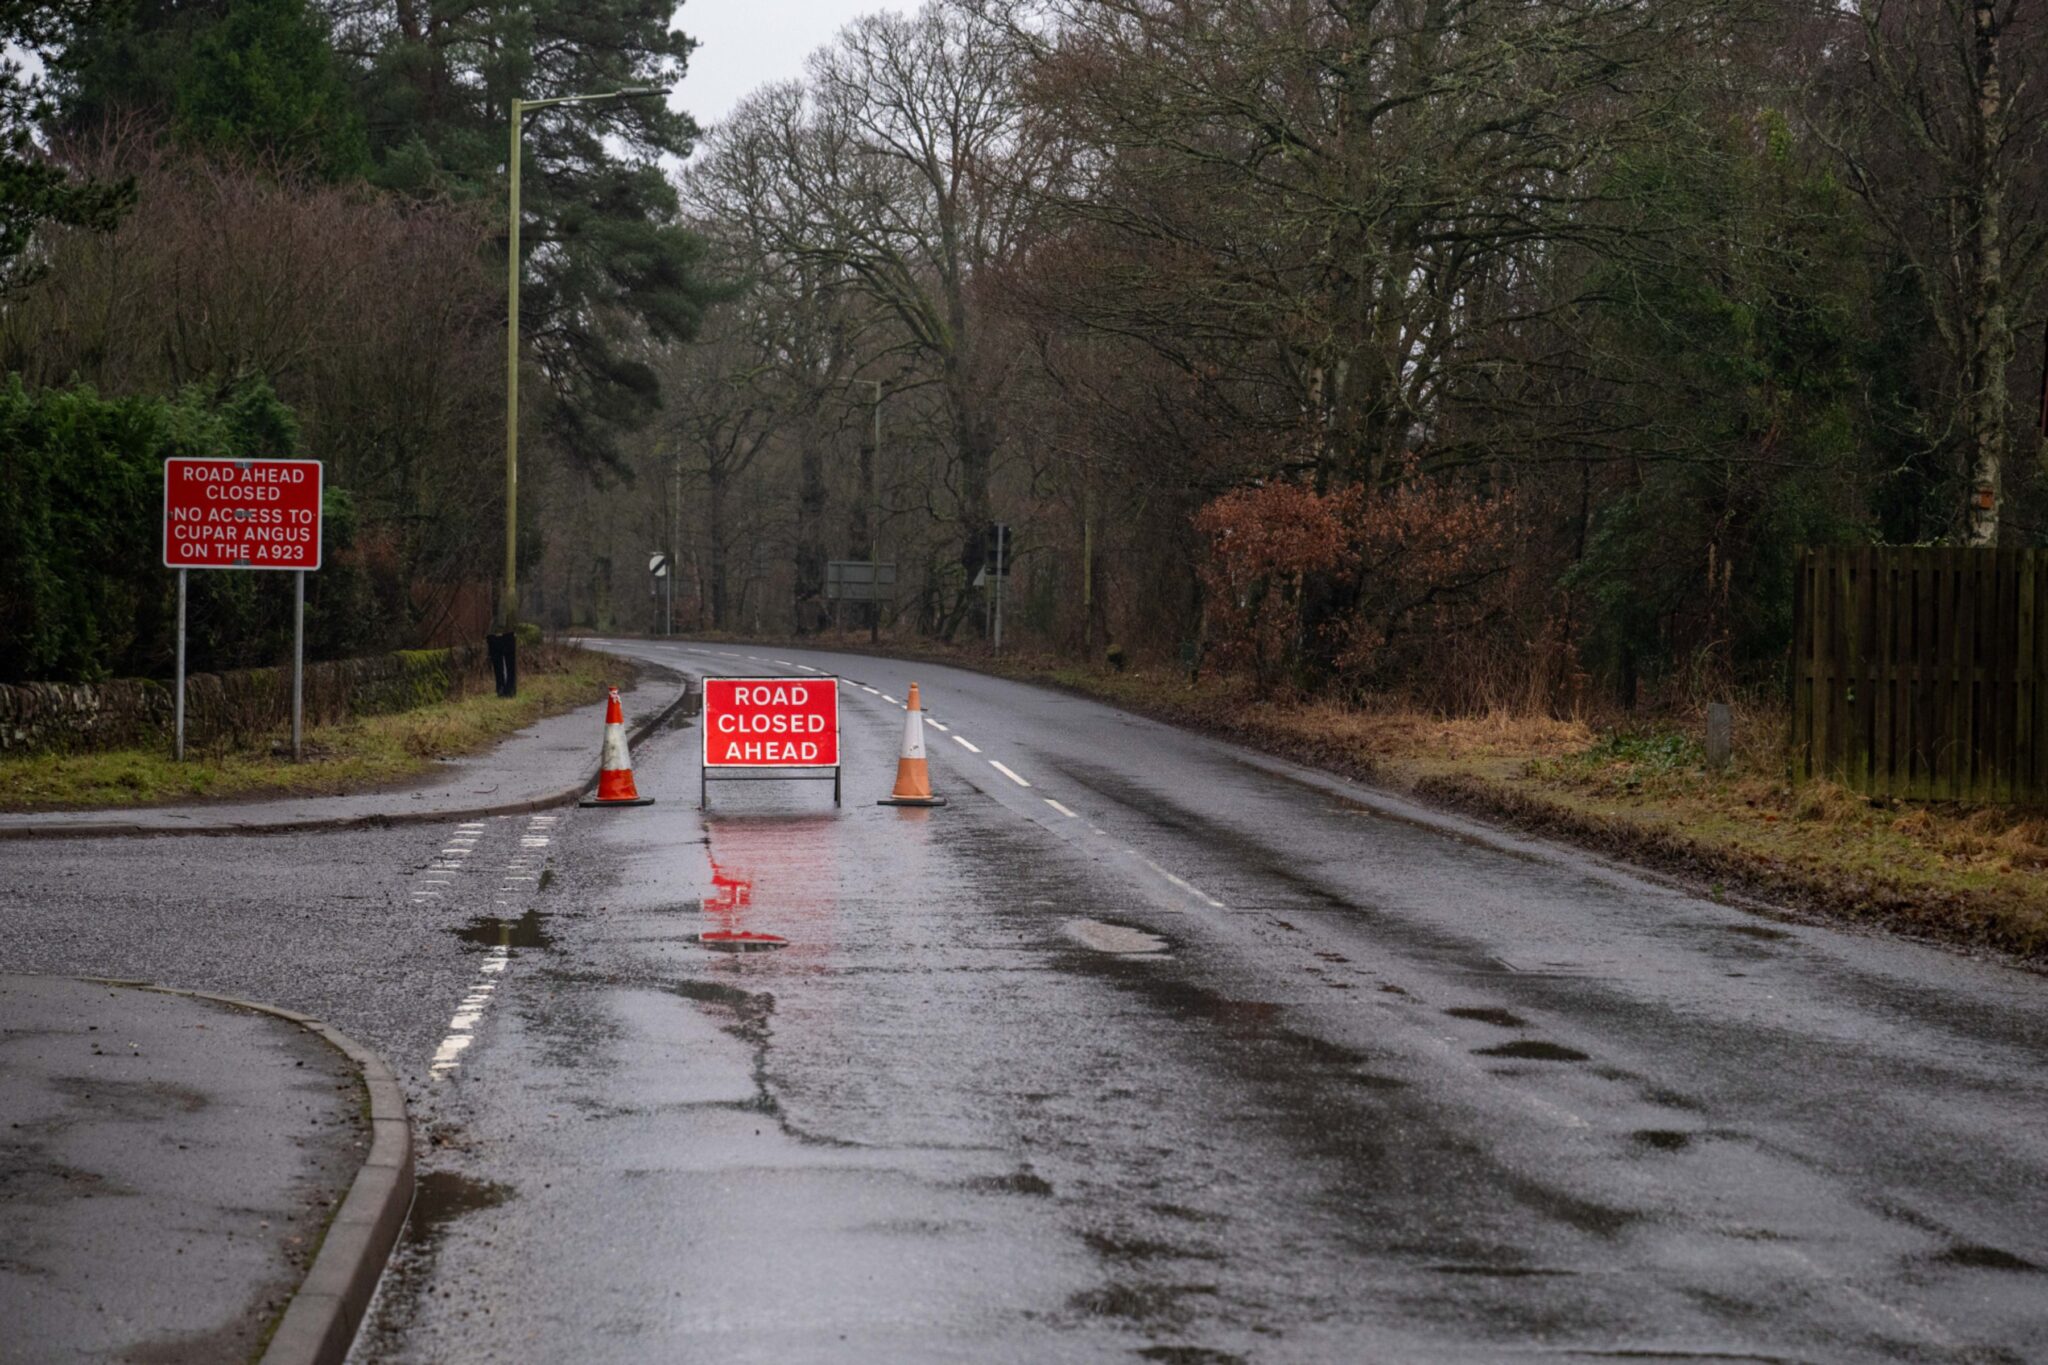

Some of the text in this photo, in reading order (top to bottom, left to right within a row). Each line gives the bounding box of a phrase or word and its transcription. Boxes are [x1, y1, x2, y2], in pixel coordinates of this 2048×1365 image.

[183, 467, 305, 483] ROAD AHEAD
[206, 485, 281, 501] CLOSED
[174, 507, 313, 524] NO ACCESS TO
[174, 525, 311, 542] CUPAR ANGUS
[180, 543, 208, 558] ON
[215, 544, 250, 559] THE
[734, 686, 809, 706] ROAD
[718, 713, 826, 734] CLOSED
[725, 741, 818, 761] AHEAD
